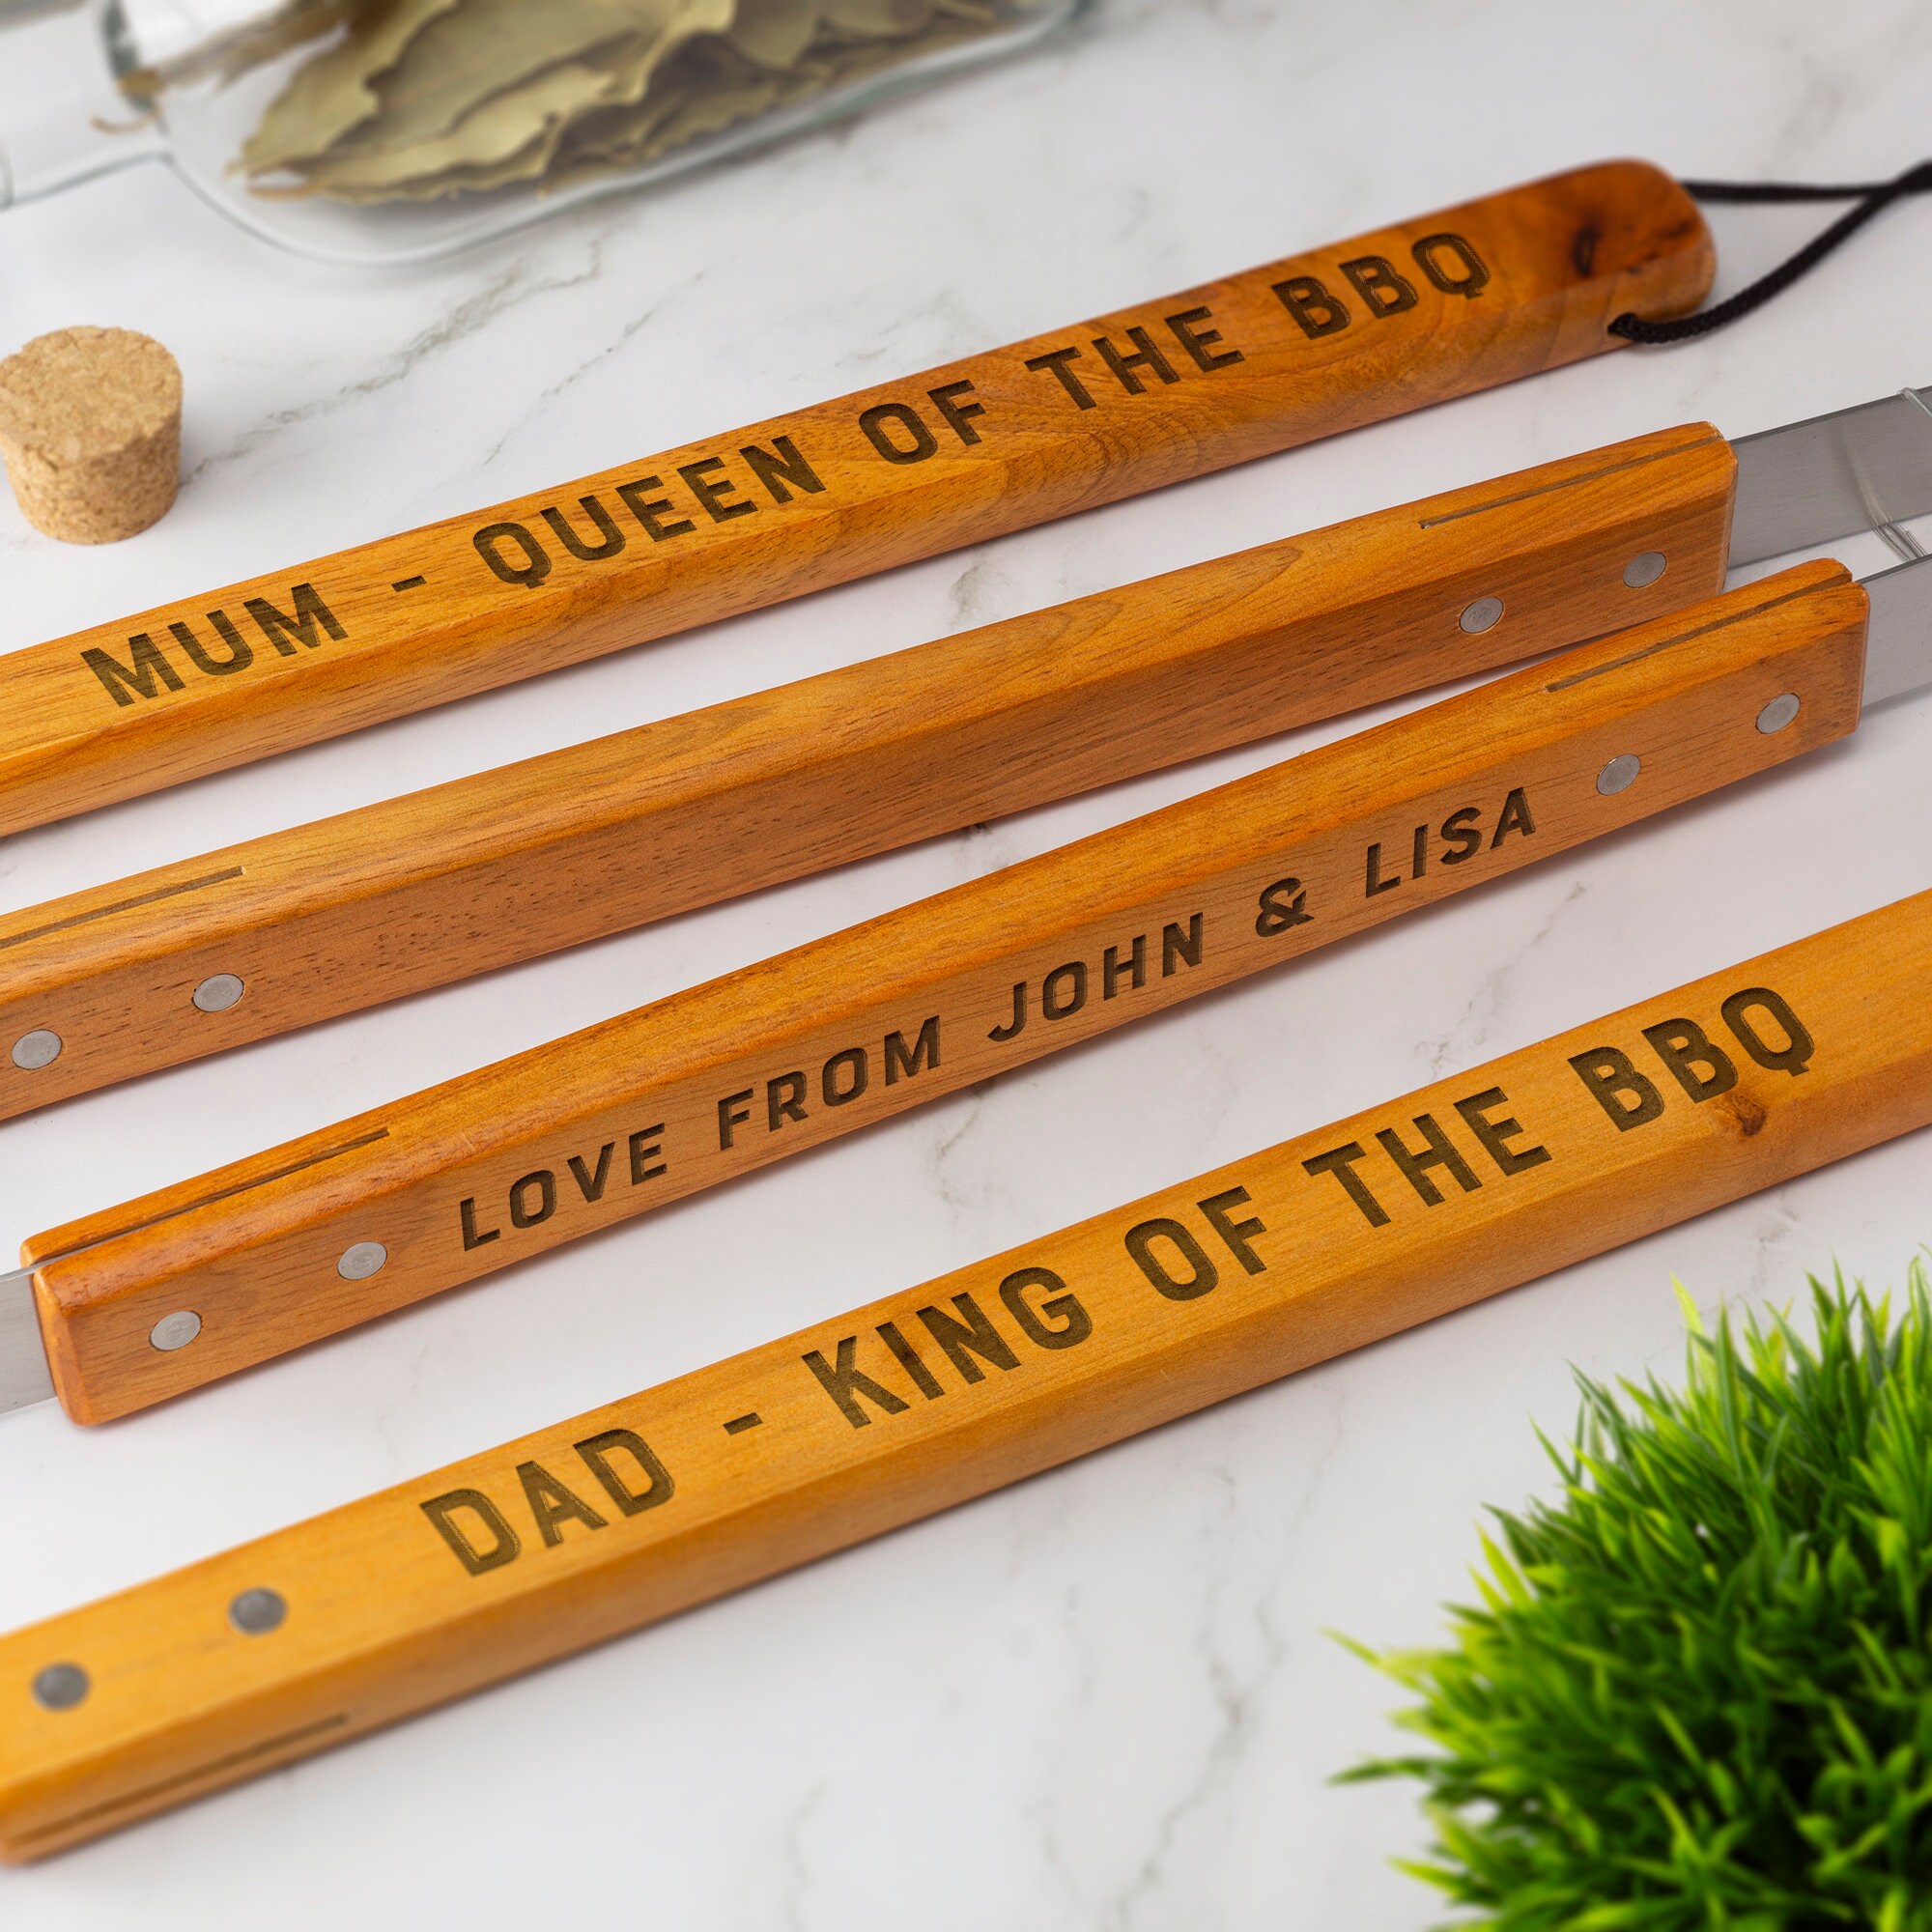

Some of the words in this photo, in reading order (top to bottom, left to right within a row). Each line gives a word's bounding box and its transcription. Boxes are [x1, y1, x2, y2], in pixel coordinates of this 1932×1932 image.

[81, 583, 347, 707] MUM
[391, 575, 427, 592] -
[473, 436, 826, 588] QUEEN
[859, 380, 986, 466] OF
[1024, 306, 1244, 411] THE
[1270, 232, 1491, 341] BBQ
[460, 1122, 667, 1251] LOVE
[718, 1015, 940, 1151] FROM
[987, 912, 1203, 1041] JOHN
[1255, 876, 1316, 937] &
[1366, 787, 1536, 898] LISA
[419, 1428, 676, 1575] DAD
[724, 1413, 764, 1435] -
[802, 1267, 1092, 1430] KING
[1125, 1186, 1266, 1301] OF
[1301, 1087, 1551, 1229] THE
[1568, 986, 1815, 1132] BBQ
